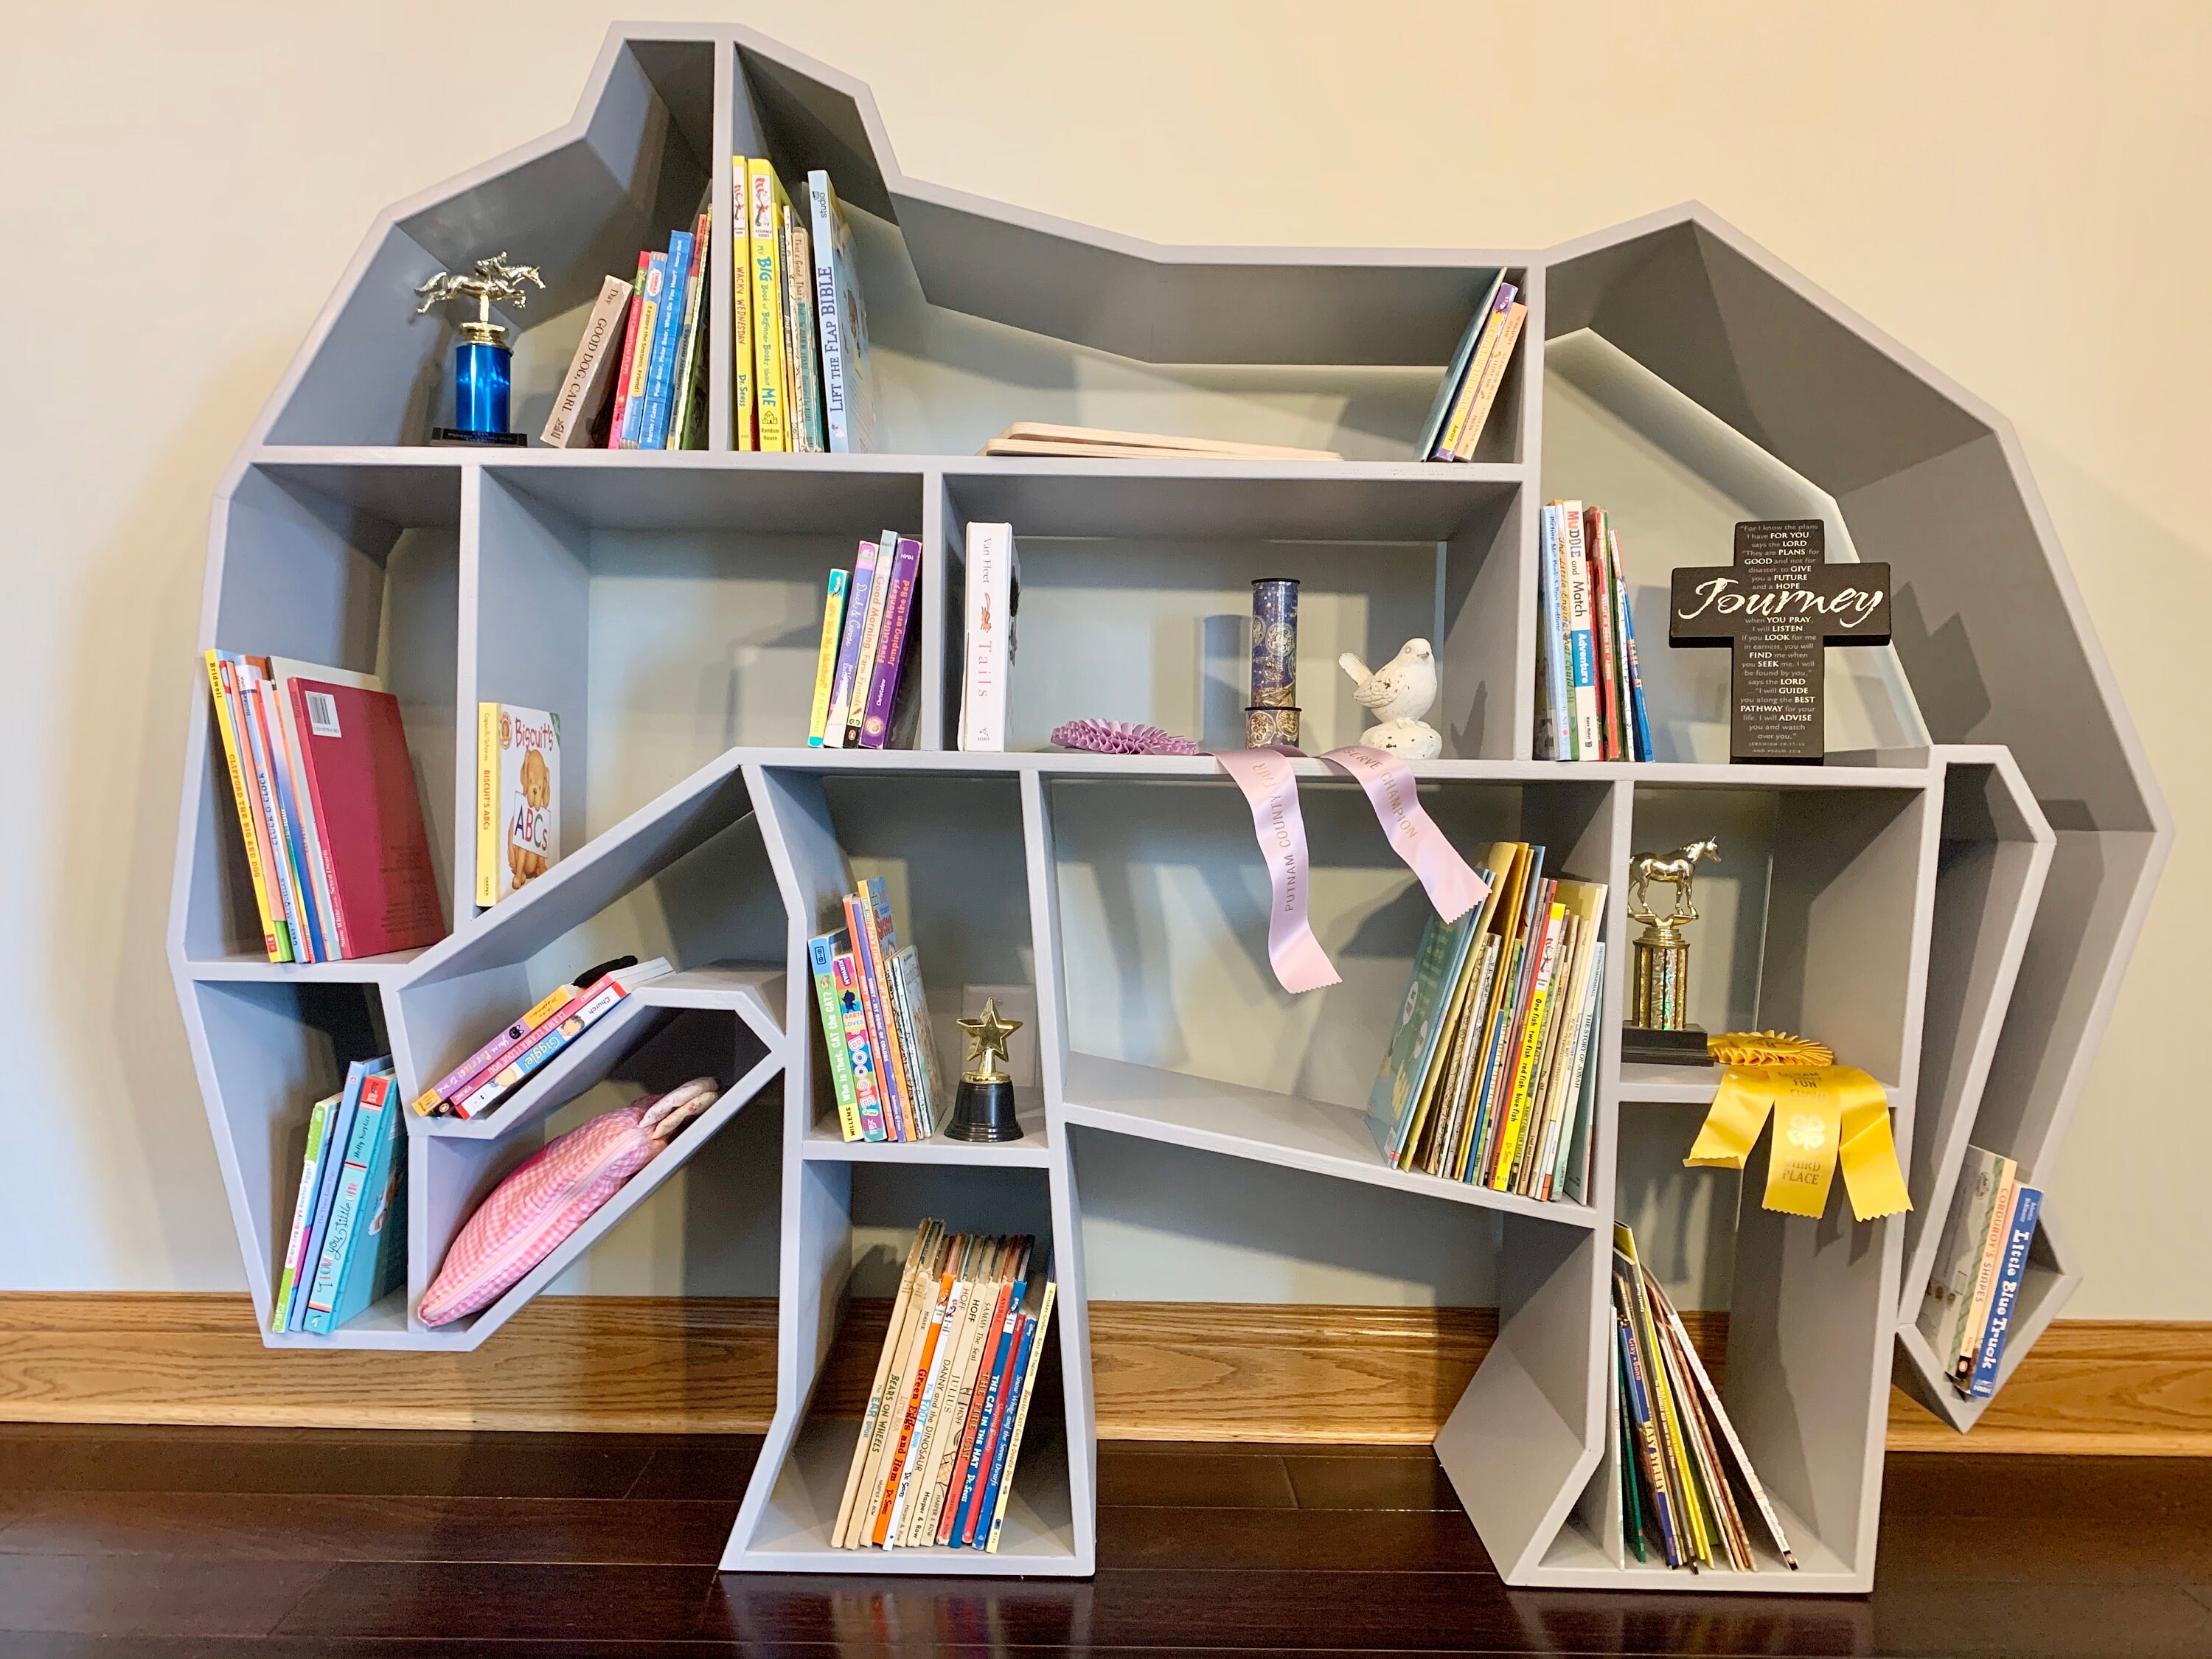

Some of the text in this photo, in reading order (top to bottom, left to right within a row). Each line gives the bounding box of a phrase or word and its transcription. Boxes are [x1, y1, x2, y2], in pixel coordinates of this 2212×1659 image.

[757, 245, 765, 254] MY
[757, 256, 772, 282] BIG
[603, 288, 618, 305] Day
[736, 266, 747, 344] WACKY WEDNESDAY
[761, 311, 771, 343] Beginner
[818, 266, 844, 411] LIFT THE FLAP BIBLE
[560, 316, 608, 414] GOOD DOG, CARL
[762, 344, 772, 365] Books
[764, 368, 773, 385] about
[762, 387, 776, 407] ME
[982, 538, 991, 583] Van Fleet
[1568, 511, 1586, 617] MUDDLE and Match
[877, 578, 901, 664] Five Little Monkeys
[887, 580, 910, 667] Jumping on the Bed
[1678, 578, 1883, 628] Journey
[852, 576, 885, 707] Good Morning, Farm Friends
[1578, 633, 1589, 684] Adventure
[875, 678, 886, 706] Christelow
[977, 640, 992, 697] Tails
[516, 717, 553, 751] Biscuit's
[227, 754, 260, 877] CLIFFORD THE BIG RED DOG
[514, 804, 548, 851] ABCs
[1380, 771, 1418, 839] CHAMPION
[1253, 763, 1295, 912] PUTNAM COUNTY FAIR
[838, 959, 850, 985] KIRWAN
[588, 995, 611, 1015] Church
[486, 1009, 566, 1075] LLAMA LLAMA LOVE YOU
[518, 1032, 562, 1070] Giggle!
[824, 990, 851, 1101] Who Is That, CAT the CAT?
[1510, 998, 1542, 1122] One fish two fish red fish blue fish
[1579, 1054, 1585, 1062] OF
[1580, 1029, 1589, 1052] STORY
[453, 1084, 473, 1101] VIKING
[846, 1034, 878, 1119] BOOGIE!
[1573, 1063, 1583, 1088] JONAH
[1793, 1079, 1817, 1088] FUN
[845, 1106, 855, 1135] WILLEMS
[1782, 1169, 1820, 1185] PLACE
[1975, 1187, 2008, 1303] CORDUROY'S SHAPES
[957, 1288, 969, 1310] HOFF
[967, 1298, 980, 1323] HOFF
[1981, 1229, 2030, 1371] Little Blue Truck
[970, 1301, 991, 1361] SAMMY The Seal
[871, 1374, 900, 1453] BEARS ON WHEELS
[914, 1359, 950, 1472] DANNY and the DINOSAUR
[942, 1374, 960, 1413] JULIUS
[954, 1406, 964, 1425] HOFF
[959, 1371, 990, 1461] THE FIRE CAT
[889, 1368, 927, 1482] Green Eggs and Ham
[969, 1374, 1000, 1468] THE CAT IN THE HAT
[990, 1374, 1023, 1486] Snow White and the Seven Dwarfs
[1643, 1420, 1666, 1494] EASY STREET
[898, 1481, 908, 1498] Seuss
[961, 1473, 975, 1503] Dr. Seuss
